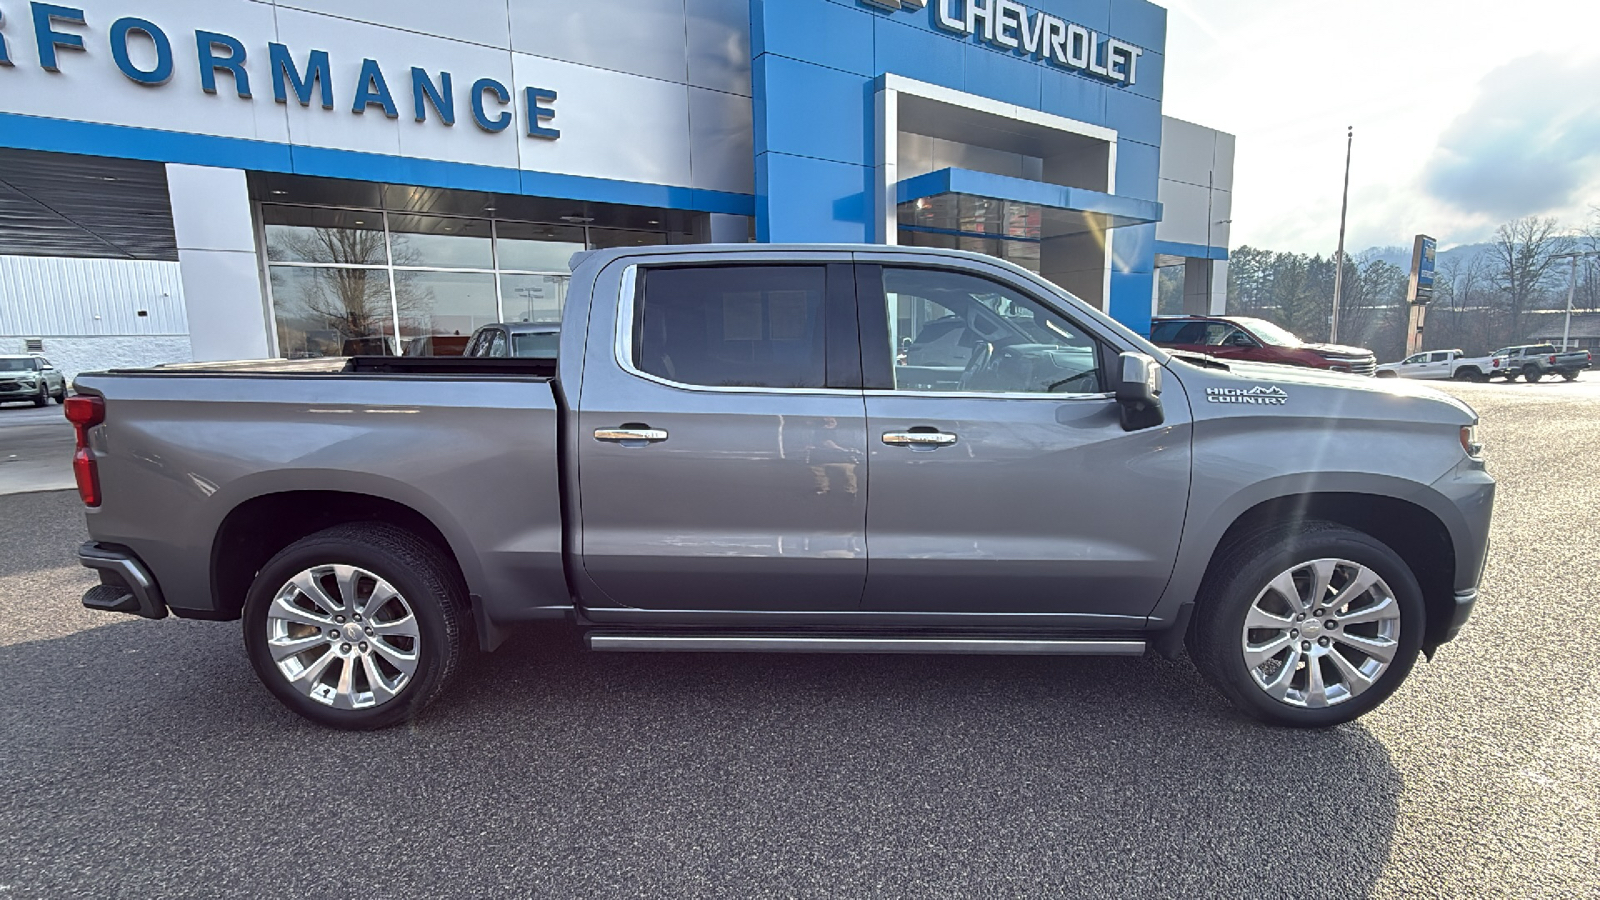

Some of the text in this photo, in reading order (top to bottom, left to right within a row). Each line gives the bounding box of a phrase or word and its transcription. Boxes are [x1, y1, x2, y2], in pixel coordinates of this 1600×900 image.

[939, 0, 1142, 85] CHEVROLET
[0, 0, 561, 140] FORMANCE
[1206, 387, 1248, 396] HIGH
[1207, 395, 1288, 405] COUNTRY
